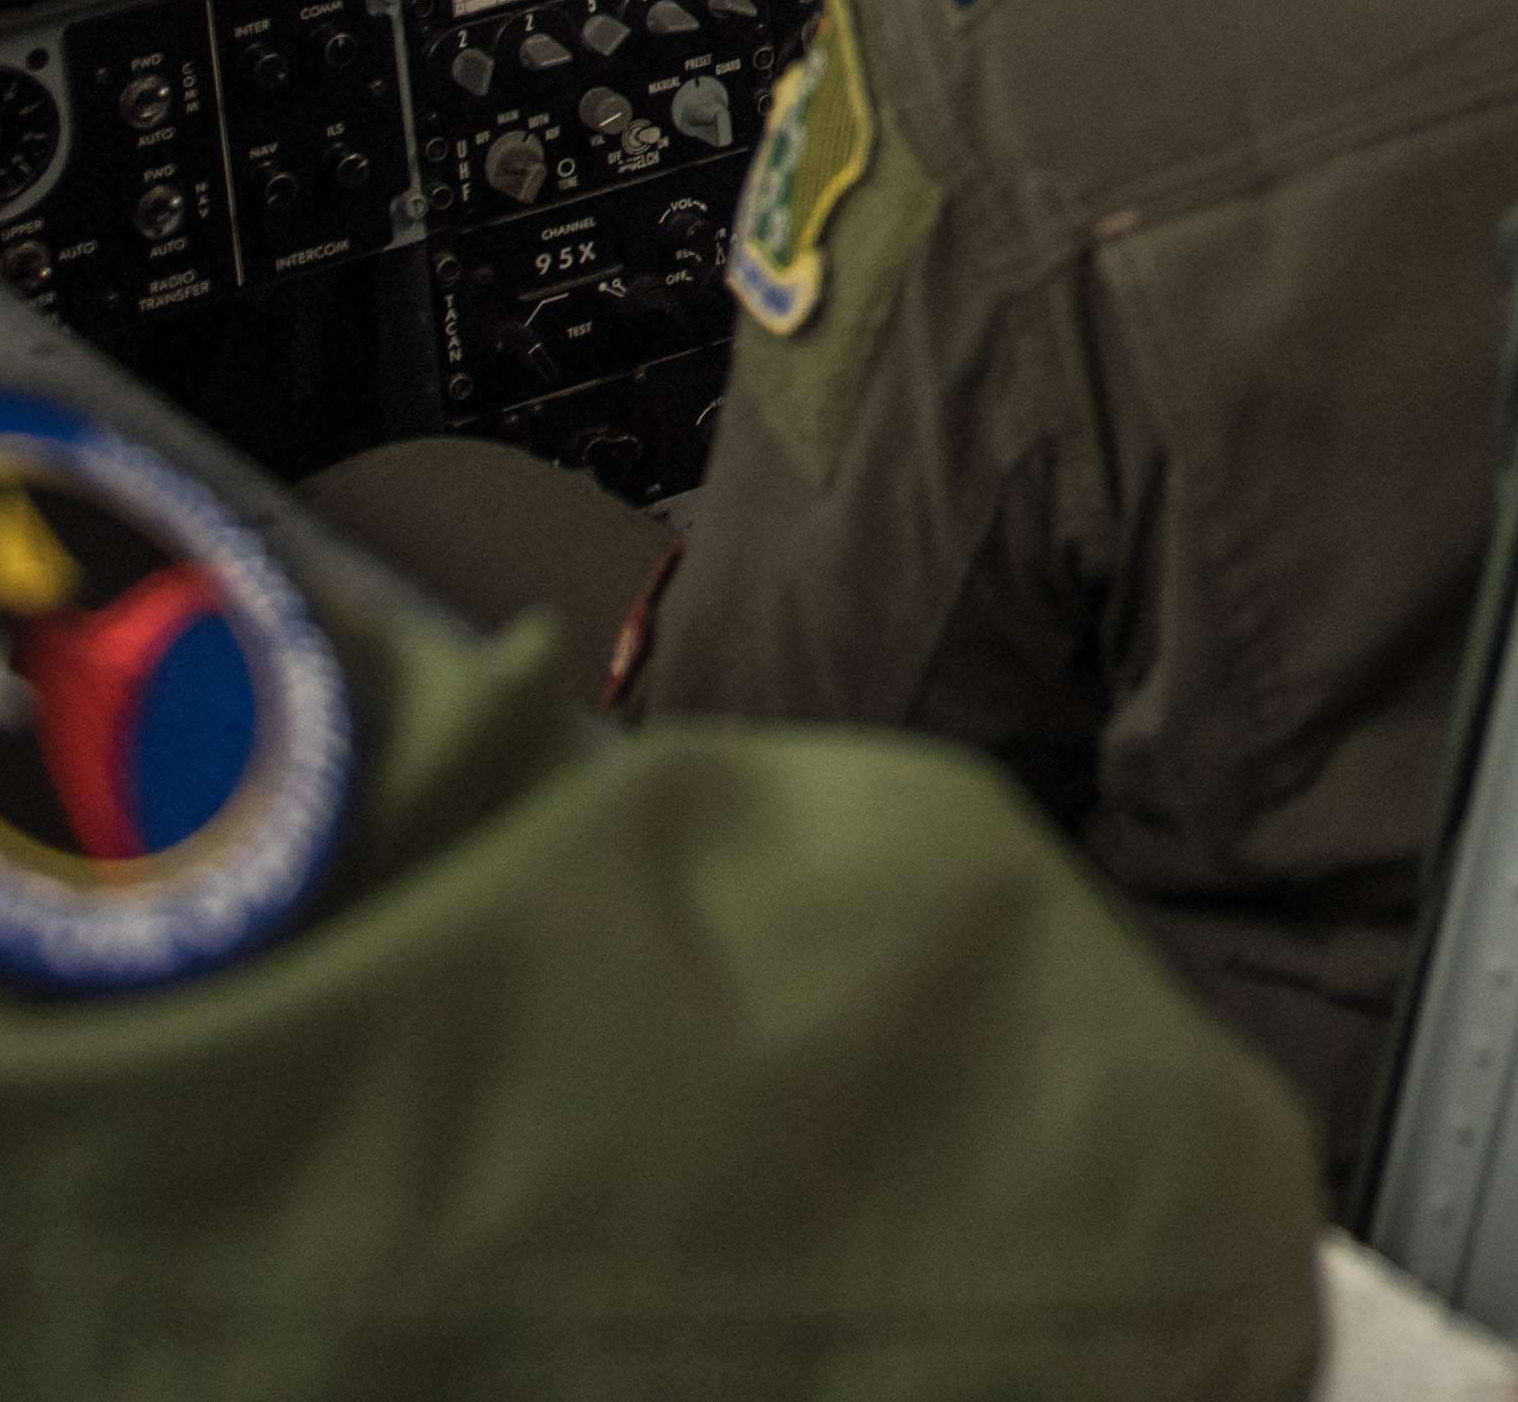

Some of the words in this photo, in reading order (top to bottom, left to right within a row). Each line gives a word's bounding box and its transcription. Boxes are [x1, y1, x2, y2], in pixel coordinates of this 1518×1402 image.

[299, 0, 346, 21] COMM
[234, 17, 273, 39] INTER
[525, 12, 535, 33] 2
[458, 29, 469, 50] 2
[130, 51, 165, 71] FWD
[684, 52, 714, 71] PRESET
[714, 57, 743, 77] GUARD
[181, 60, 200, 114] COMM
[647, 75, 682, 96] MANUAL
[137, 126, 178, 149] AUTO
[326, 121, 347, 139] ILS
[248, 141, 280, 160] NAV
[142, 161, 178, 183] FWD
[455, 138, 472, 203] UHF
[194, 180, 211, 220] NAV
[670, 196, 693, 212] VOL
[0, 217, 45, 242] UPPER
[540, 215, 597, 241] CHANNEL
[57, 238, 100, 262] AUTO
[149, 236, 189, 259] AUTO
[274, 237, 351, 273] INTERCOM
[534, 241, 597, 277] 95X
[148, 268, 198, 295] RADIO
[665, 268, 688, 286] OFF
[137, 280, 212, 313] TRANSFER
[443, 293, 464, 363] TACAN
[566, 321, 594, 340] TEST
